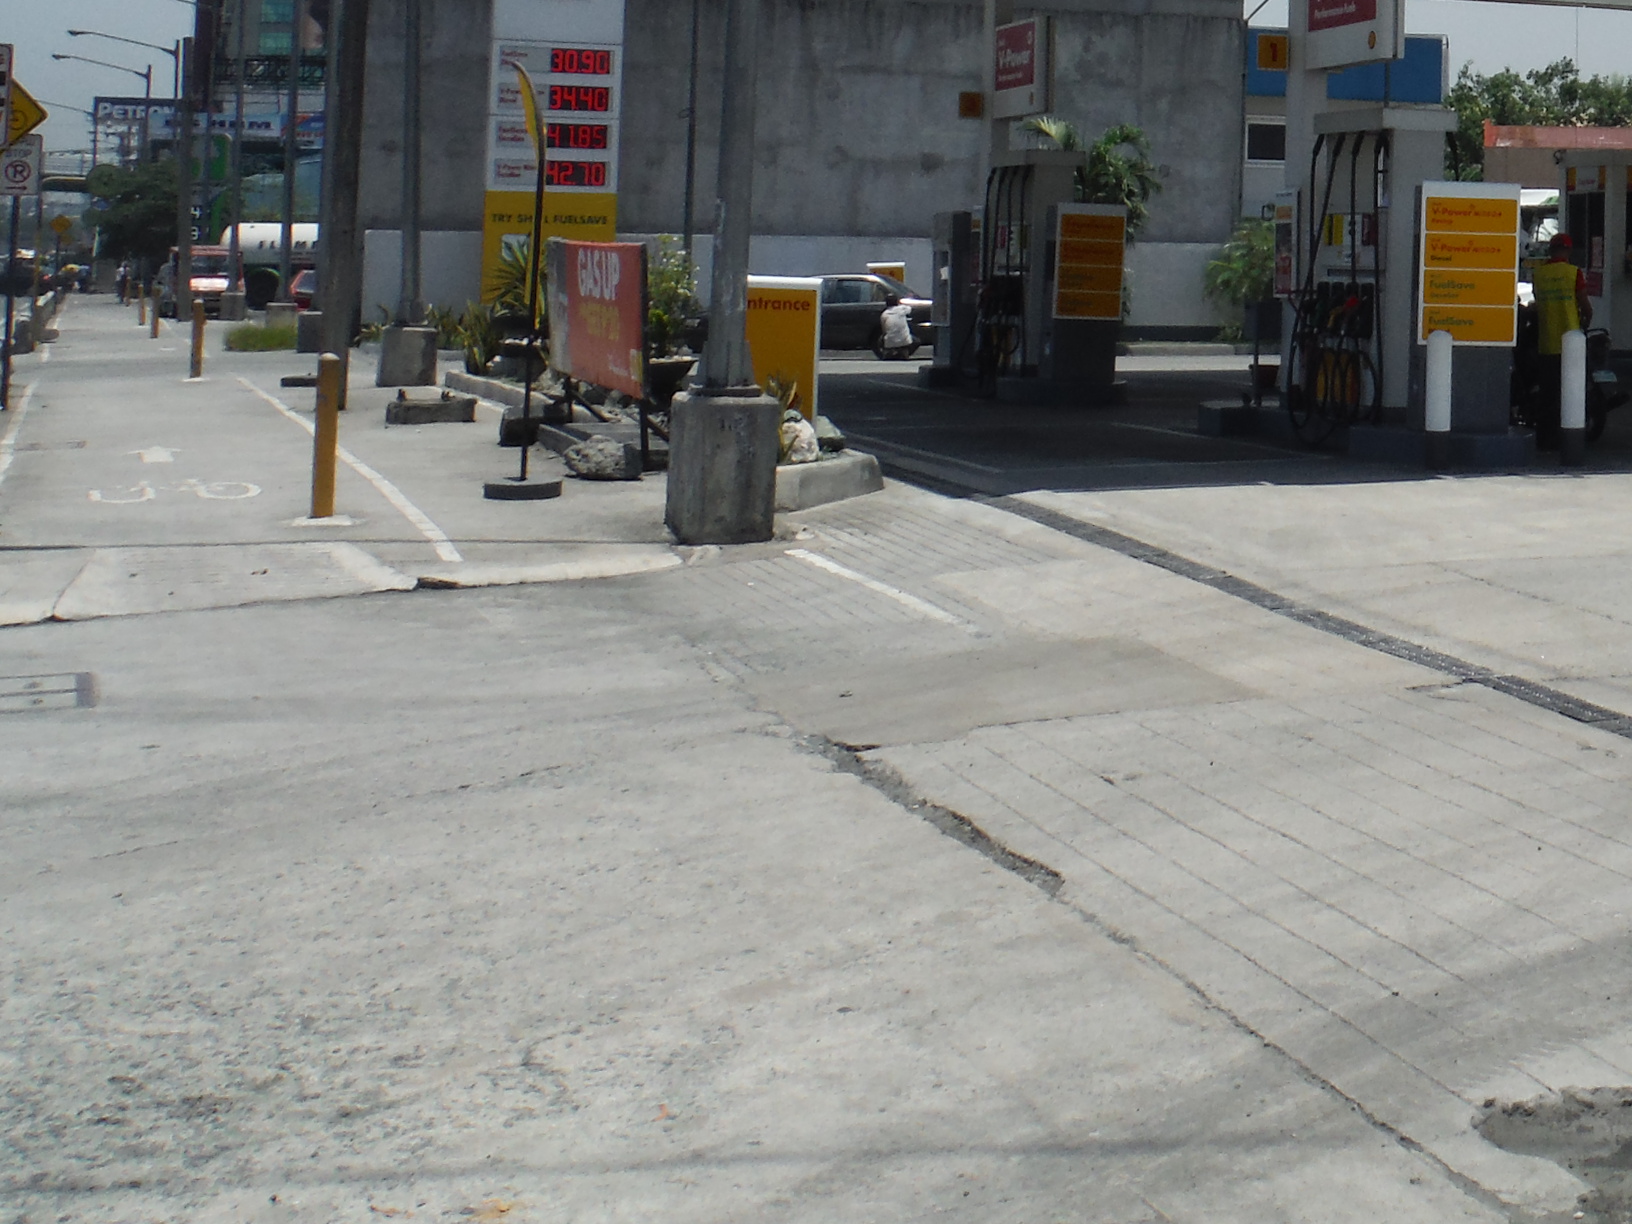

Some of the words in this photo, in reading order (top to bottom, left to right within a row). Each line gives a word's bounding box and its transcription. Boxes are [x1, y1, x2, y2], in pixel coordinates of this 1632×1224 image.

[551, 48, 609, 75] 30.90
[549, 86, 608, 112] 34.40
[547, 124, 607, 149] 41.85
[546, 162, 606, 187] 42.70
[516, 214, 549, 225] SHL
[577, 247, 601, 299] GAS
[602, 250, 621, 301] UP
[747, 298, 810, 311] ntrance
